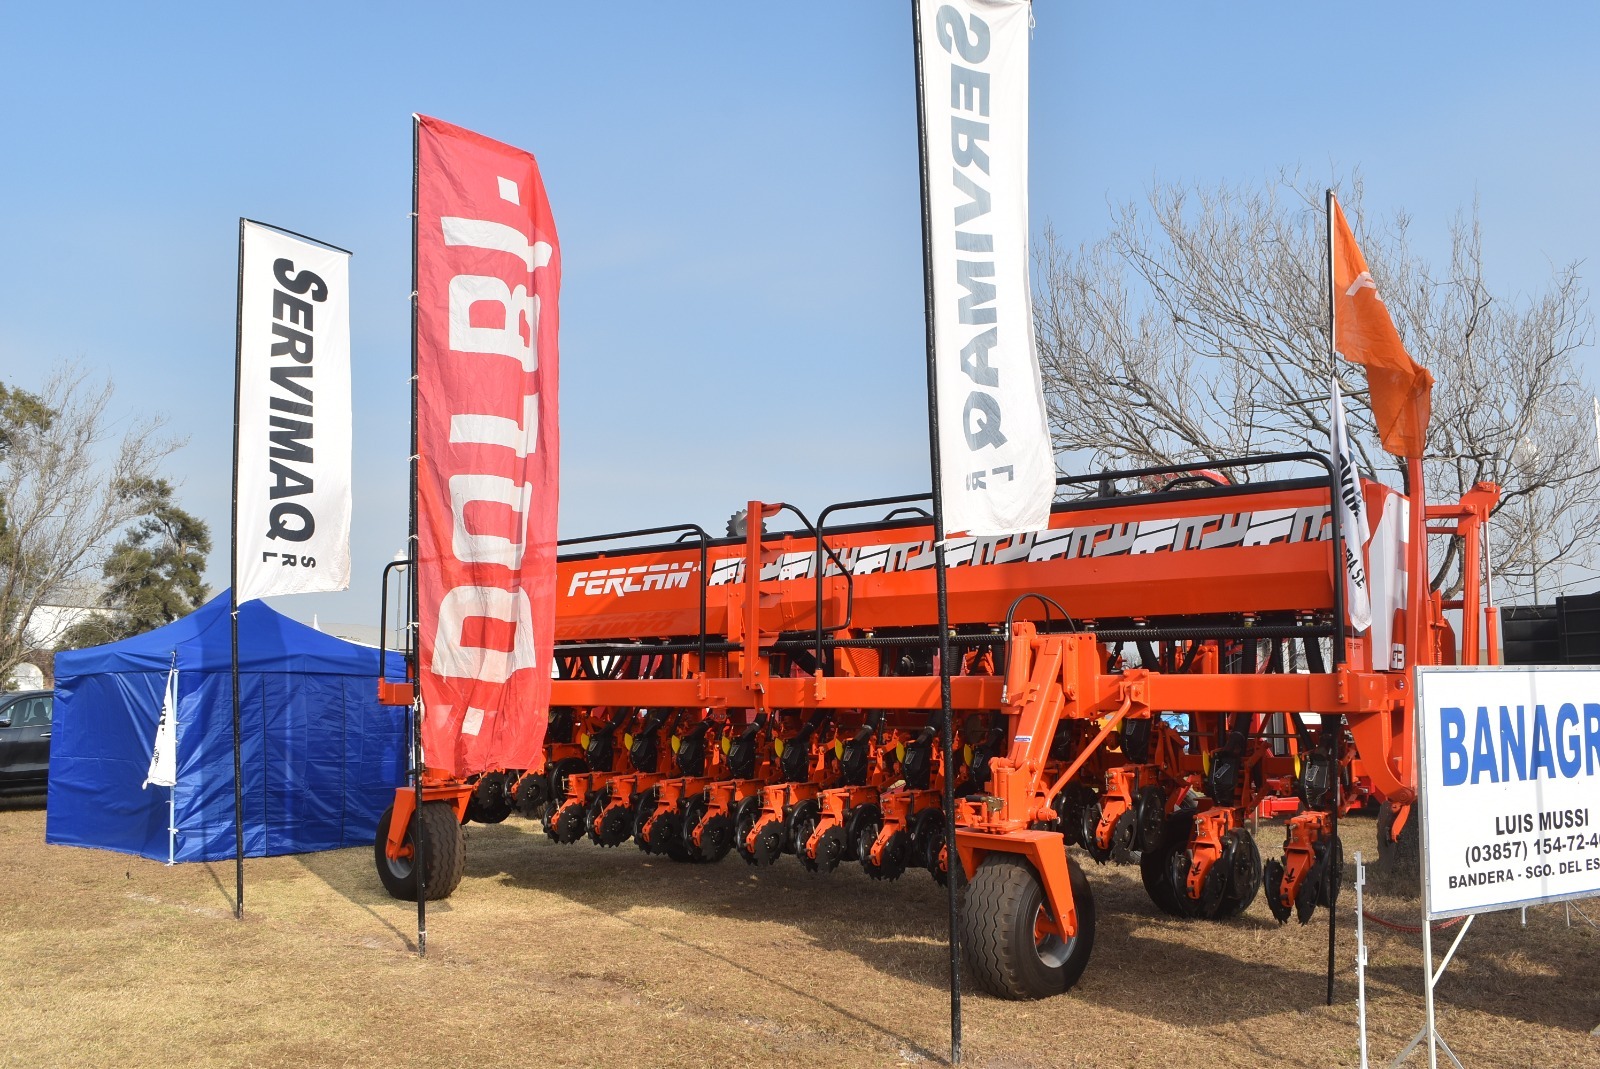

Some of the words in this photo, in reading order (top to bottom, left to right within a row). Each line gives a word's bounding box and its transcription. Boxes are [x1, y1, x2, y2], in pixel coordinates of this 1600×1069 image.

[266, 257, 328, 542] SERVIMAQ
[567, 562, 694, 598] FERCAM
[1495, 813, 1534, 835] LUIS
[1539, 808, 1589, 831] MUSSI
[1465, 841, 1528, 868] (03857)
[1534, 833, 1600, 855] 154-72-4
[1448, 869, 1514, 889] BANDERA
[1525, 864, 1555, 879] SGO.
[1559, 861, 1582, 874] DEL
